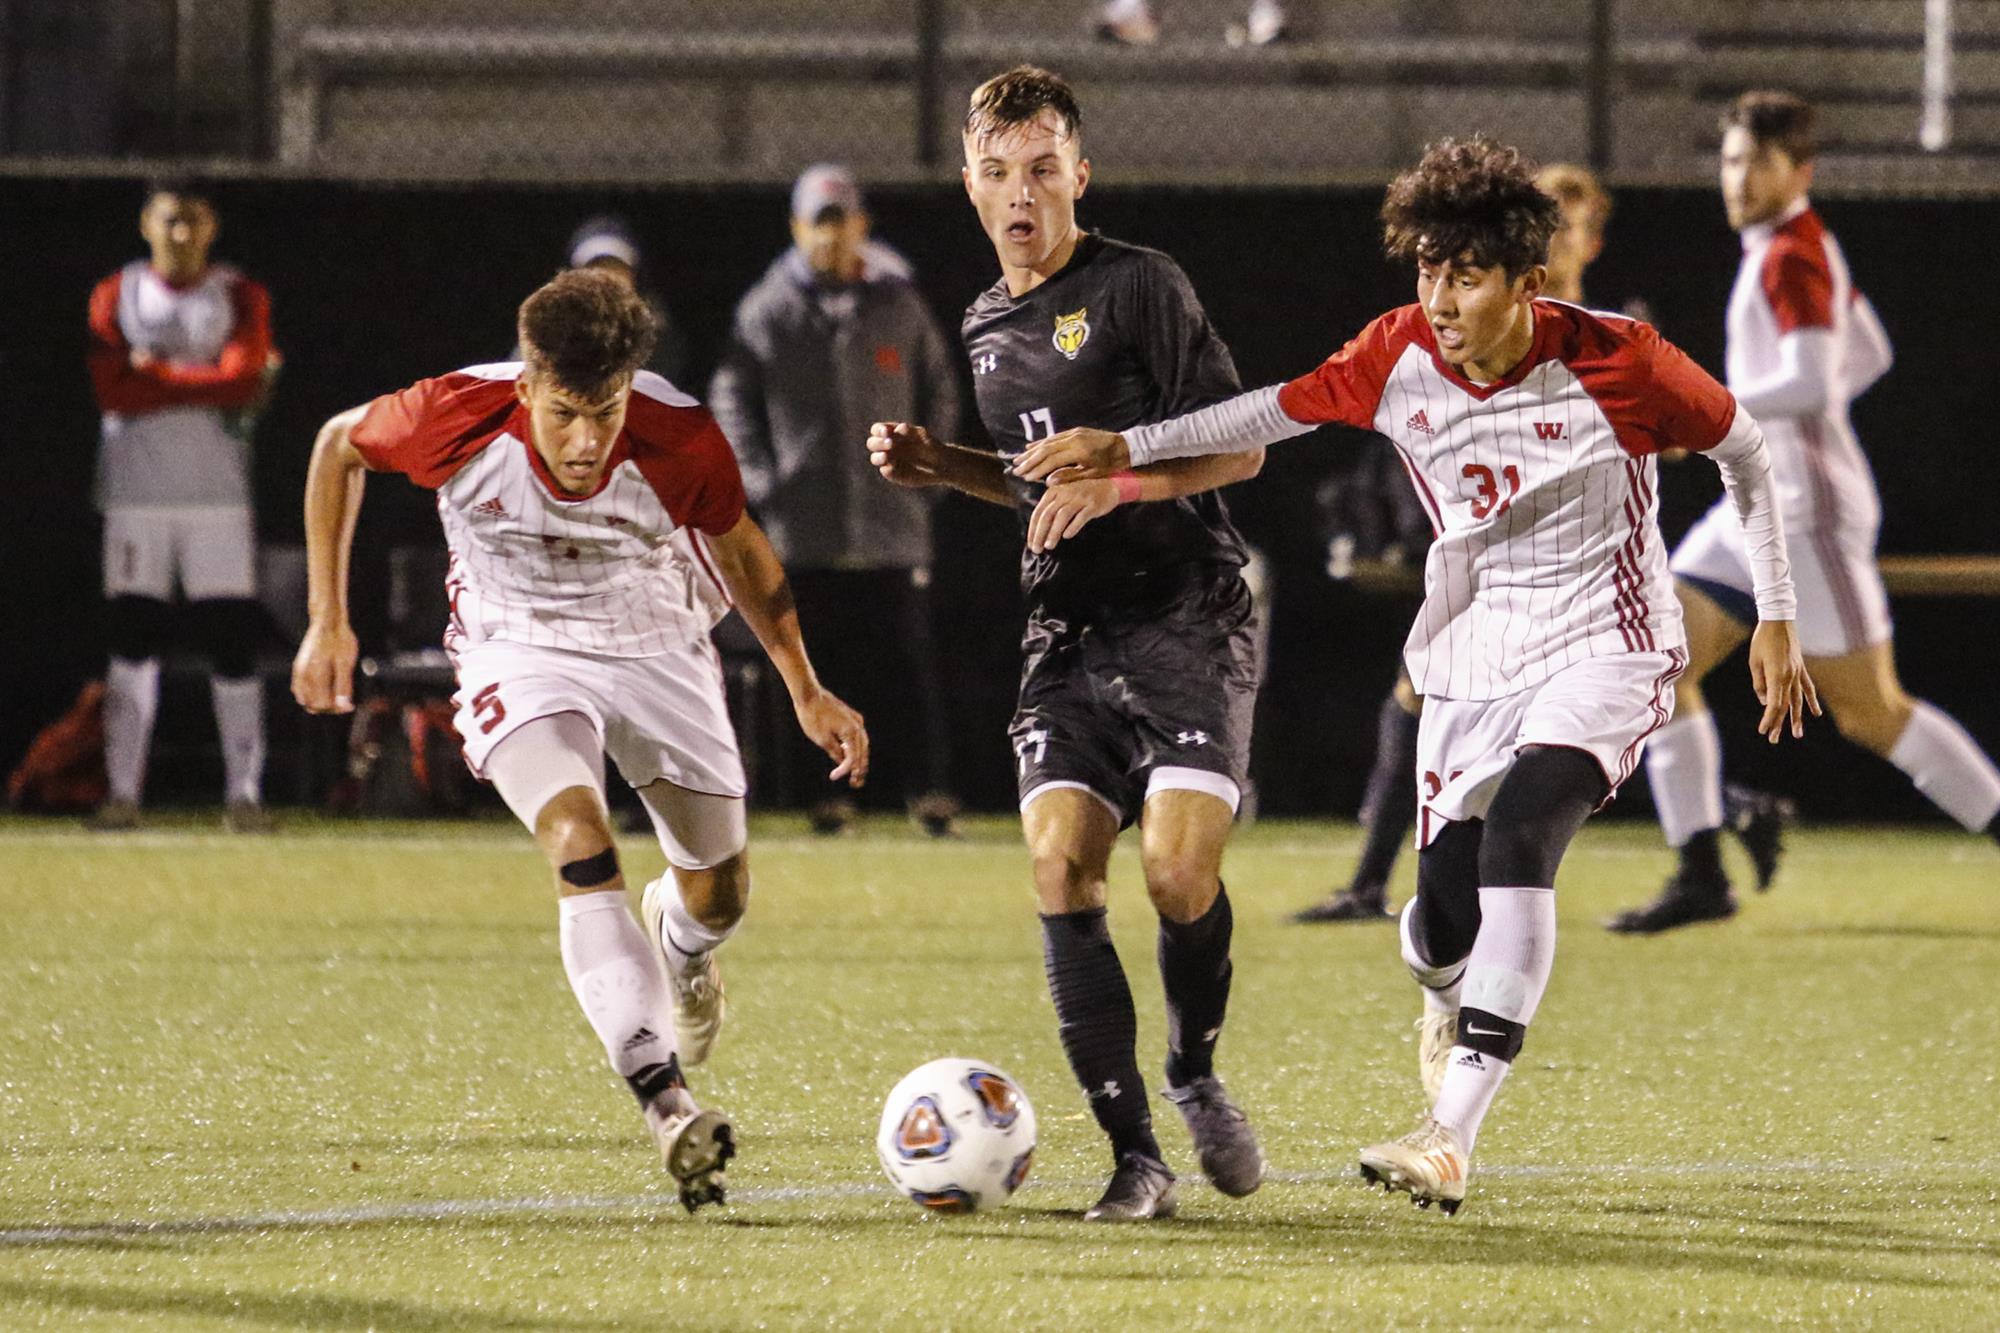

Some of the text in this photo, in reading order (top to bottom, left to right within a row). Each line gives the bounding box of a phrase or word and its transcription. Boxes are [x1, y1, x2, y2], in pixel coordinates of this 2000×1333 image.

[1018, 406, 1055, 442] 17
[1461, 463, 1520, 520] 31
[471, 682, 507, 735] 5
